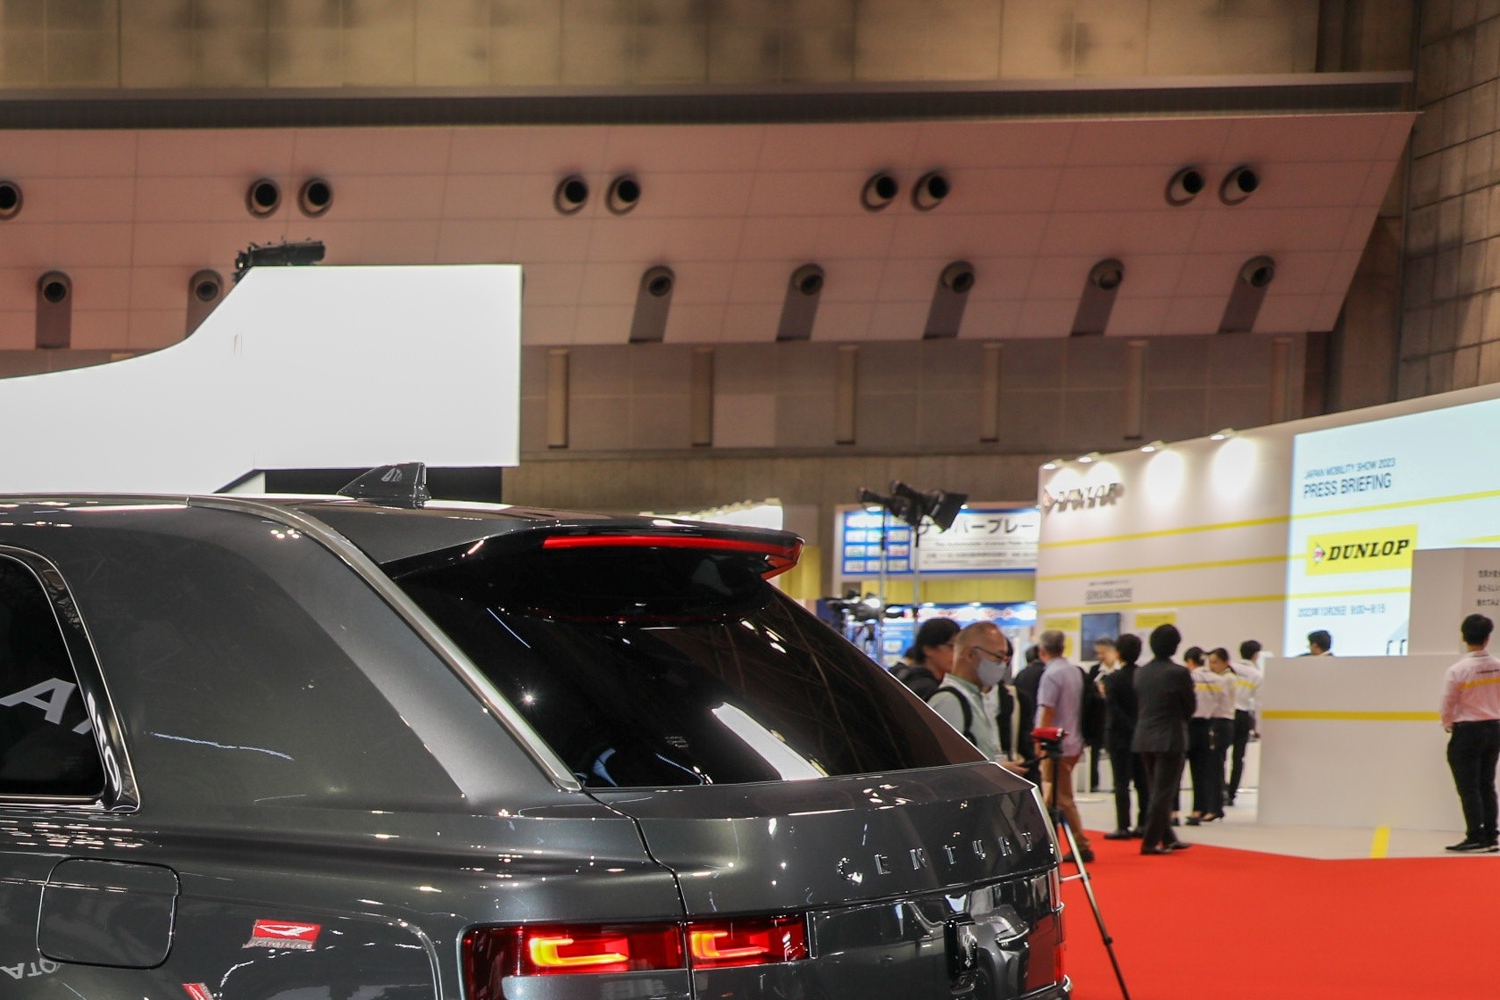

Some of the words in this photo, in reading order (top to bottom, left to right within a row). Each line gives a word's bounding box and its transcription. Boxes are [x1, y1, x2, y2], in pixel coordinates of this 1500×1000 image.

[1357, 460, 1376, 472] SHOW
[1378, 457, 1396, 469] 2023
[1303, 480, 1338, 499] PRESS
[1340, 472, 1392, 494] BRIEFING
[1328, 539, 1410, 561] DUNLOP
[836, 831, 1032, 884] CENTURY
